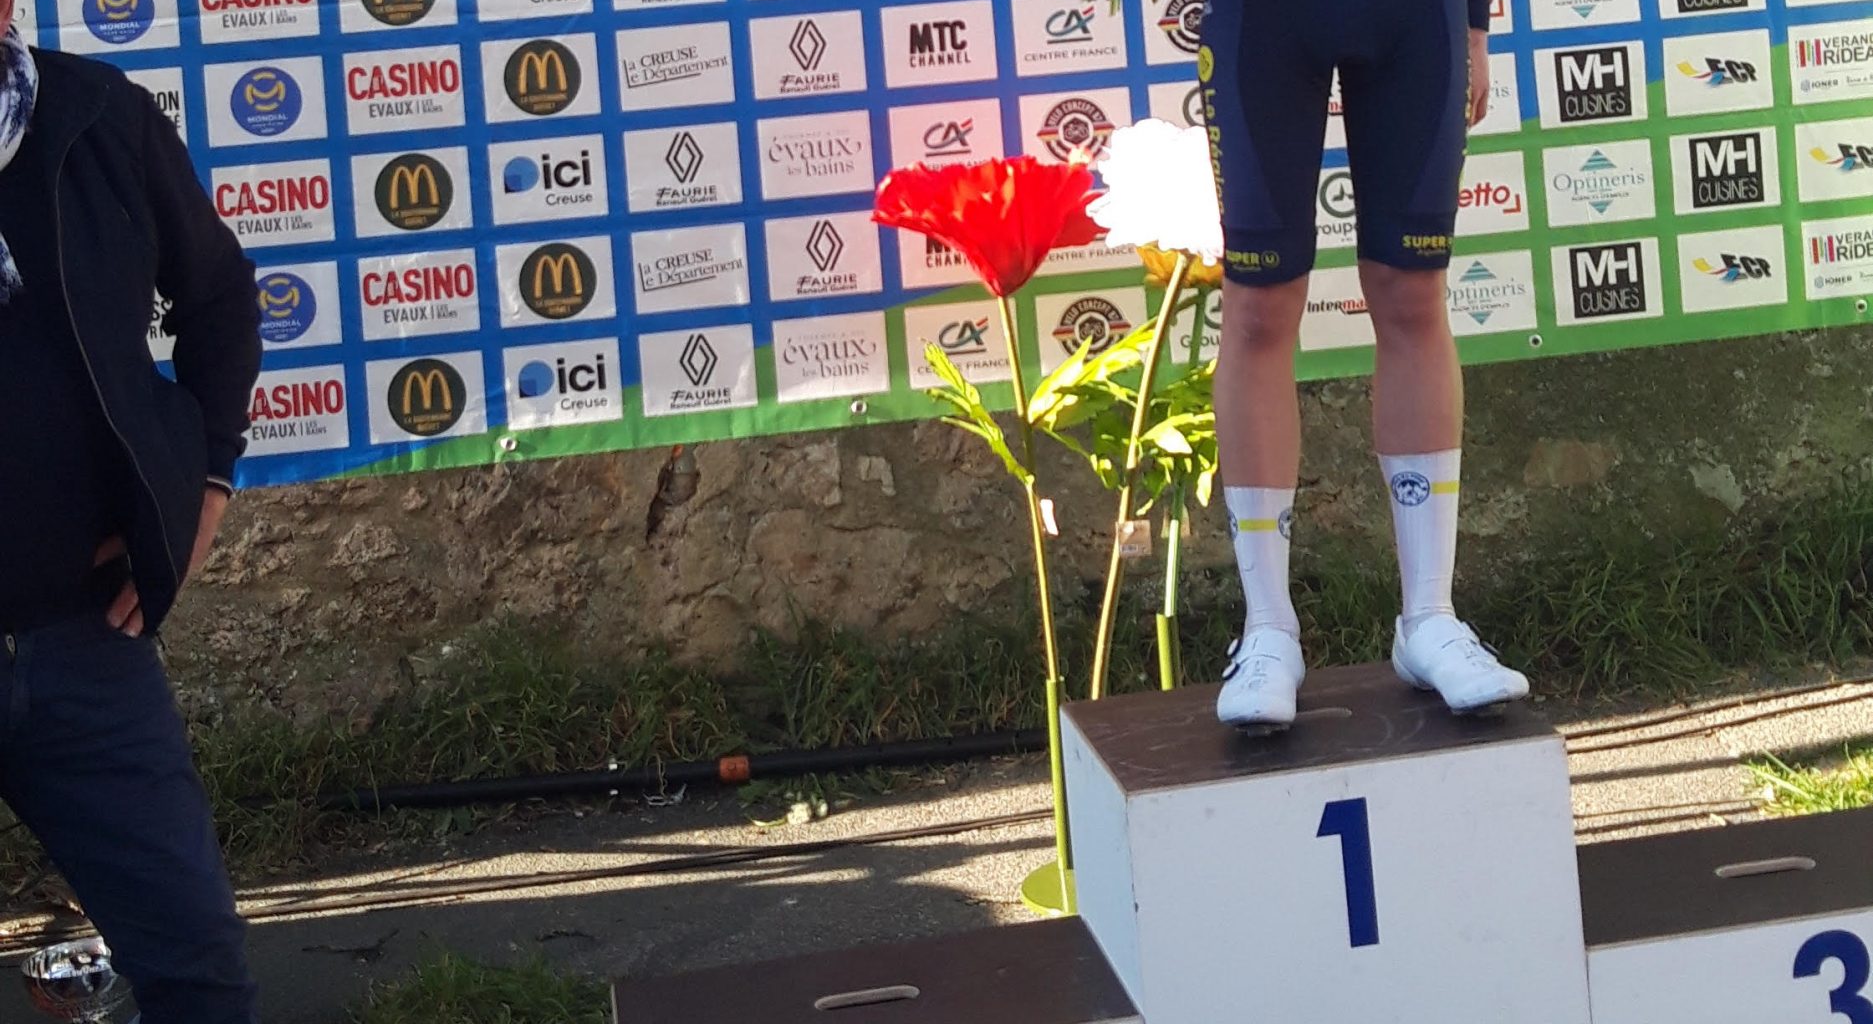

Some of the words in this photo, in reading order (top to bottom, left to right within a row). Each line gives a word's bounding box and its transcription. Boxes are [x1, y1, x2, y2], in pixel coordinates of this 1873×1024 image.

[222, 12, 266, 28] EVAUX
[909, 20, 966, 54] MTC
[1822, 37, 1873, 49] VERAN
[640, 46, 698, 68] CREUSE
[910, 51, 971, 68] CHANNEL
[1025, 50, 1070, 62] CENTRE
[1072, 46, 1118, 58] FRANCE
[348, 59, 459, 100] CASINO
[643, 55, 728, 82] Département
[1560, 51, 1624, 92] MH
[780, 73, 840, 87] FAURIE
[369, 101, 412, 118] EVAUX
[1565, 91, 1625, 116] CUISINES
[768, 136, 862, 163] évaux
[1697, 138, 1755, 177] MH
[542, 150, 592, 190] ici
[805, 159, 855, 177] bains
[656, 186, 716, 199] FAURIE
[1553, 168, 1646, 196] Optineris
[1699, 176, 1758, 203] CUISINES
[216, 175, 329, 217] CASINO
[546, 193, 593, 206] Creuse
[1459, 182, 1509, 209] etto
[237, 218, 282, 235] EVAUX
[1402, 235, 1447, 249] SUPER
[1836, 233, 1873, 244] VERA
[655, 249, 712, 271] CREUSE
[926, 253, 967, 268] CHAN
[1089, 246, 1136, 258] FRANCE
[658, 258, 743, 286] Département
[1577, 248, 1637, 286] MH
[363, 263, 474, 306] CASINO
[797, 273, 857, 287] FAURIE
[1307, 299, 1369, 314] Interma
[1580, 286, 1639, 313] CUISINES
[384, 306, 427, 324] EVAUX
[783, 338, 876, 365] évaux
[556, 354, 607, 394] ici
[820, 362, 869, 380] bains
[247, 380, 344, 421] ASINO
[560, 398, 607, 411] Creuse
[670, 388, 731, 403] FAURIE
[252, 423, 296, 440] EVAUX
[1316, 797, 1380, 948] 1
[1793, 929, 1873, 1024] 3
